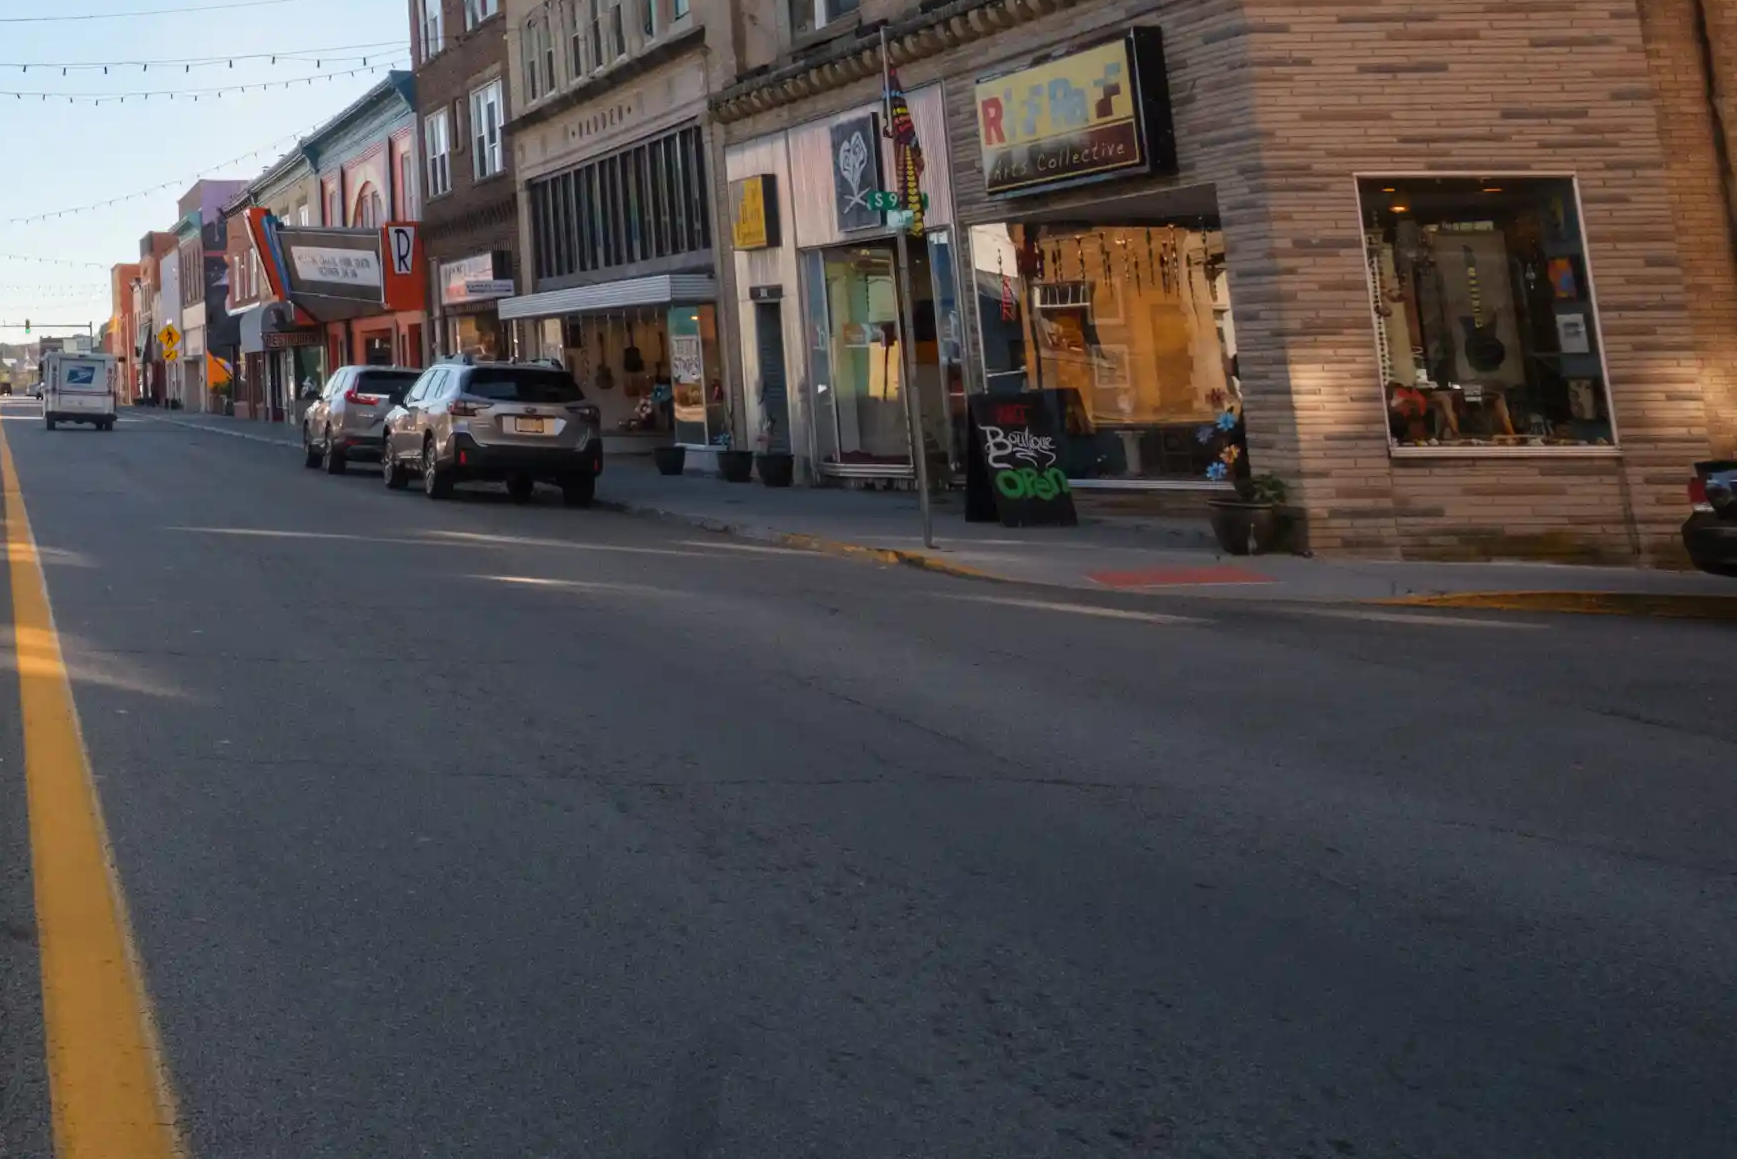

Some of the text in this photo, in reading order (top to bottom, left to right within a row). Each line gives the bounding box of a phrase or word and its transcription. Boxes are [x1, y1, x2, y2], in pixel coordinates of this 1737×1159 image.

[994, 143, 1125, 181] Arts Collective
[875, 193, 883, 207] S
[395, 229, 410, 272] R
[978, 424, 1056, 468] Boutique
